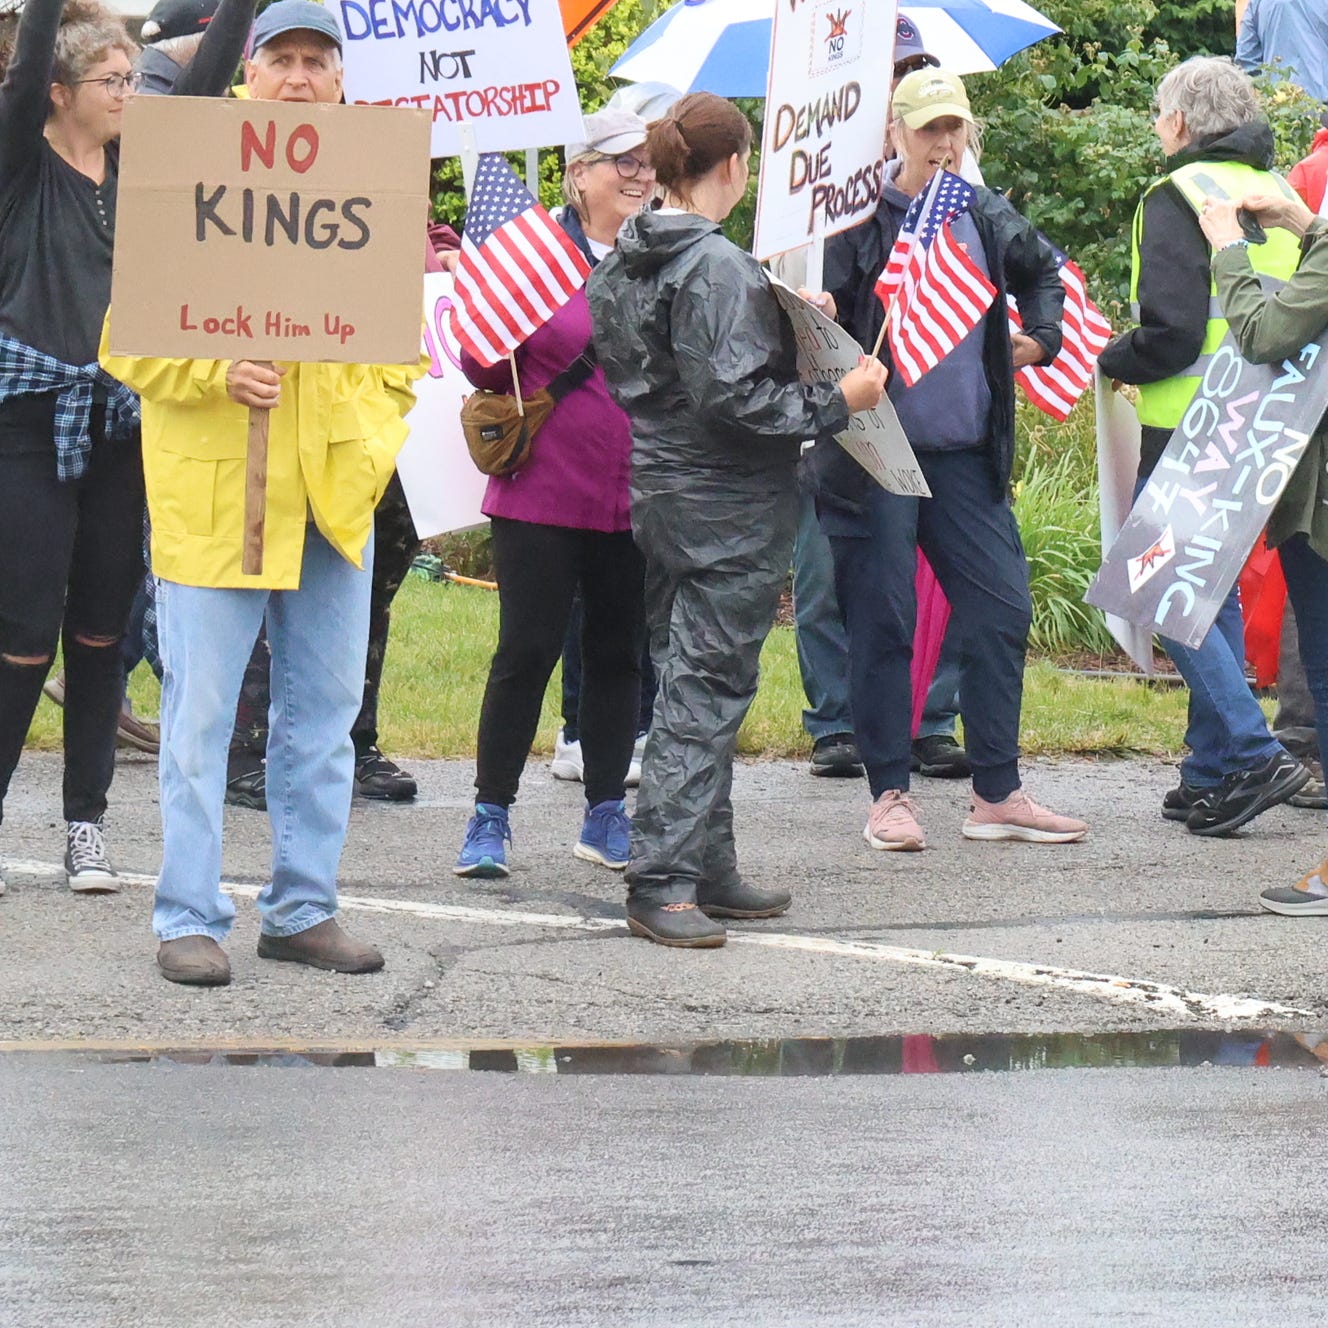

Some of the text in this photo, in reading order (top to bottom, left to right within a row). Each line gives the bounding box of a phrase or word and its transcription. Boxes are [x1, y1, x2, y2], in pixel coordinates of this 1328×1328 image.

[419, 49, 476, 84] NOT
[827, 51, 844, 62] KINGS
[828, 36, 845, 54] NO
[241, 120, 319, 174] NO
[773, 80, 862, 153] DEMAND
[788, 141, 832, 196] DUE
[807, 159, 884, 236] PROCESS
[195, 181, 372, 250] KINGS
[180, 304, 355, 345] Lock Him Up
[1147, 345, 1244, 514] 8647
[1178, 390, 1261, 516] WAY
[1154, 342, 1322, 626] FAUX-KING
[1256, 427, 1310, 506] NO
